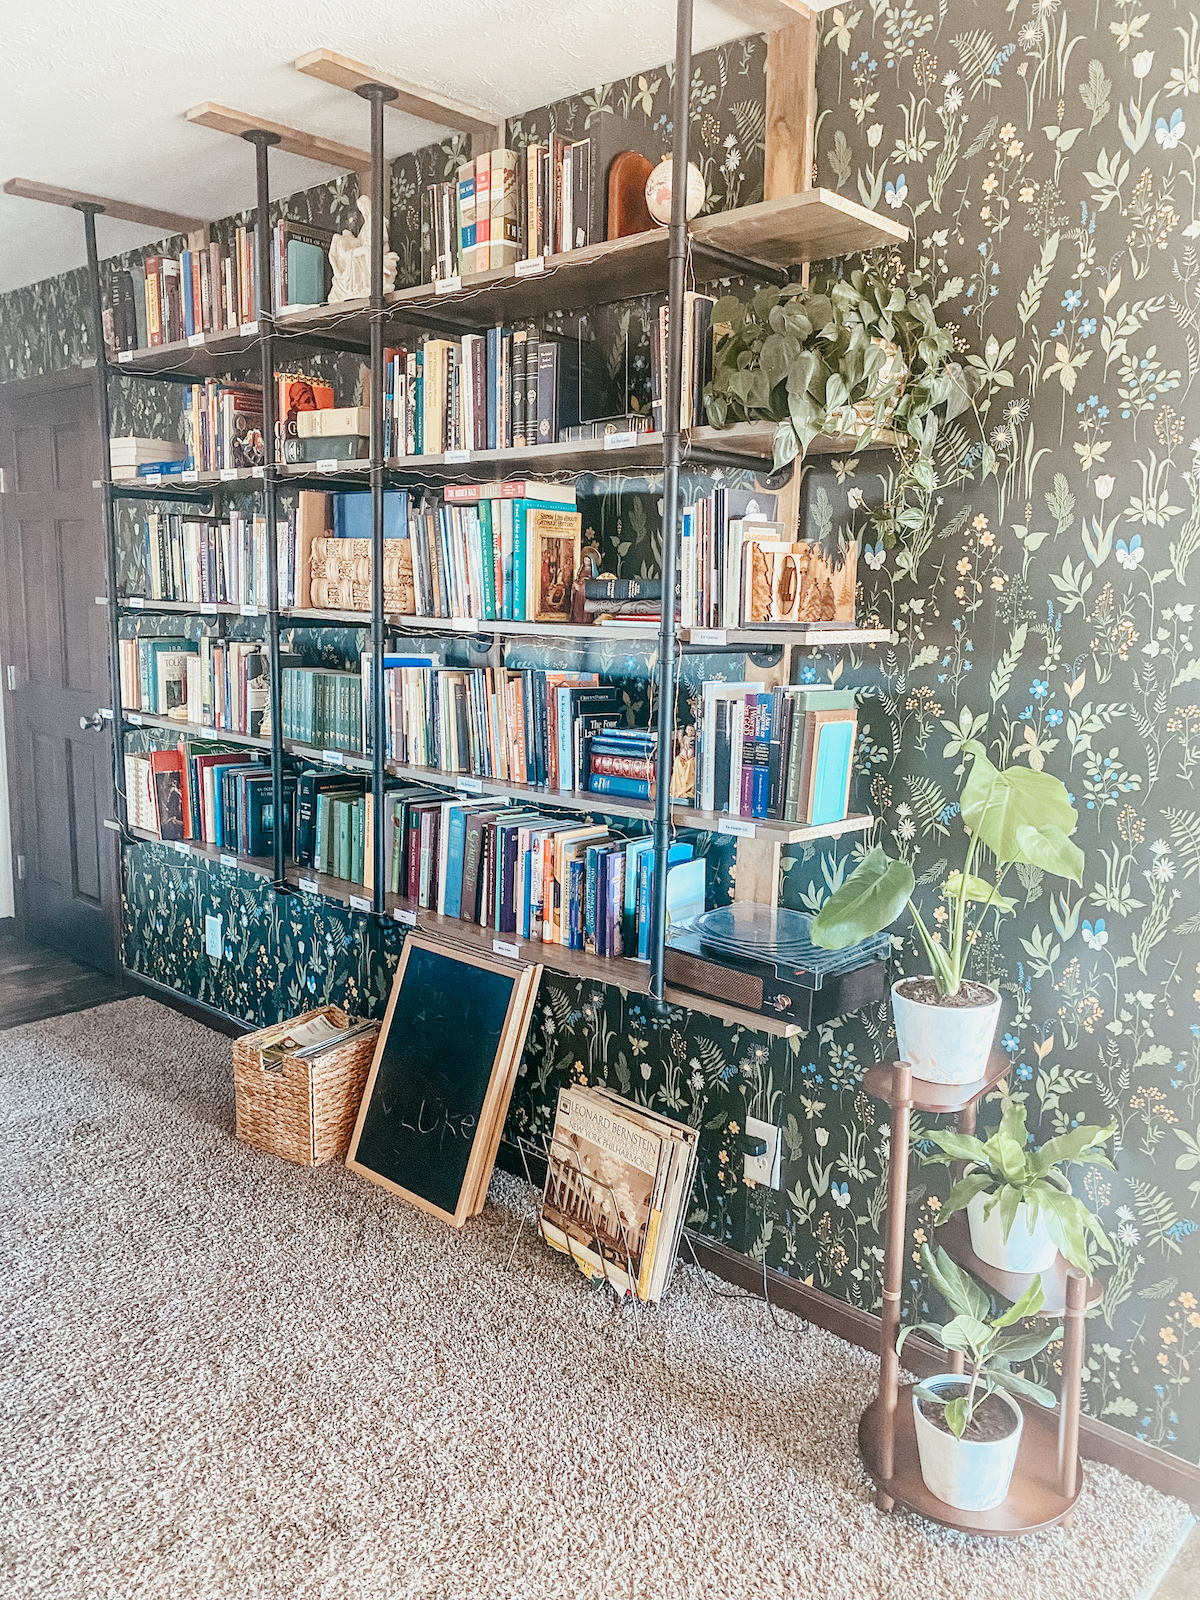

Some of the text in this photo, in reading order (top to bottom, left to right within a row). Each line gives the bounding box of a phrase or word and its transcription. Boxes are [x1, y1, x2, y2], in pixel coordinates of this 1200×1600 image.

[455, 489, 466, 497] HIDDEN
[467, 488, 476, 496] NAZI
[590, 719, 618, 729] The Four
[585, 729, 596, 738] Last
[571, 1101, 657, 1154] LEONARD BERNSTEIN
[568, 1120, 654, 1173] NEW YORK PHILHARMONIC
